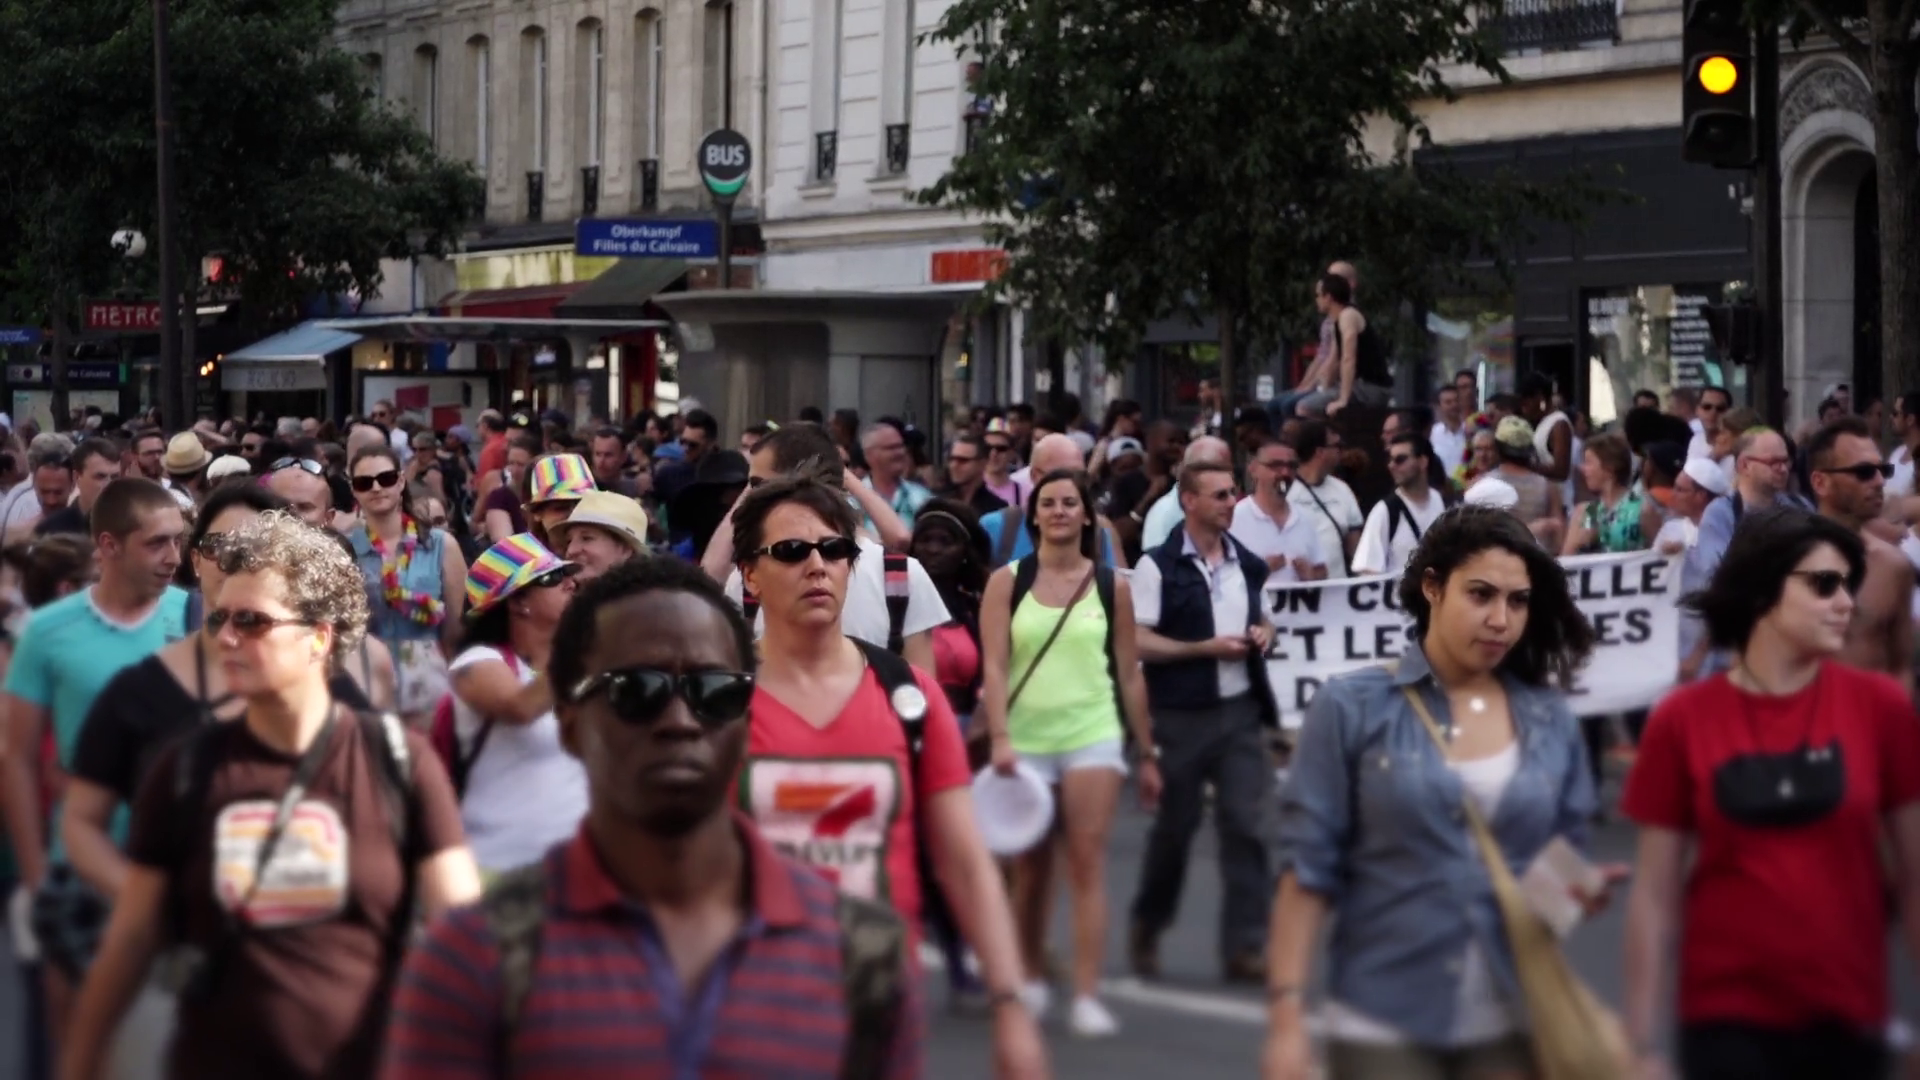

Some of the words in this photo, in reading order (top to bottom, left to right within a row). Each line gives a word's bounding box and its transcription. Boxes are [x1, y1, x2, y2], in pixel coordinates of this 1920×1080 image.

[706, 145, 746, 166] BUS
[610, 224, 683, 240] Oberkampf
[592, 240, 628, 252] Filles
[629, 239, 648, 252] du
[650, 239, 700, 254] Calvaire
